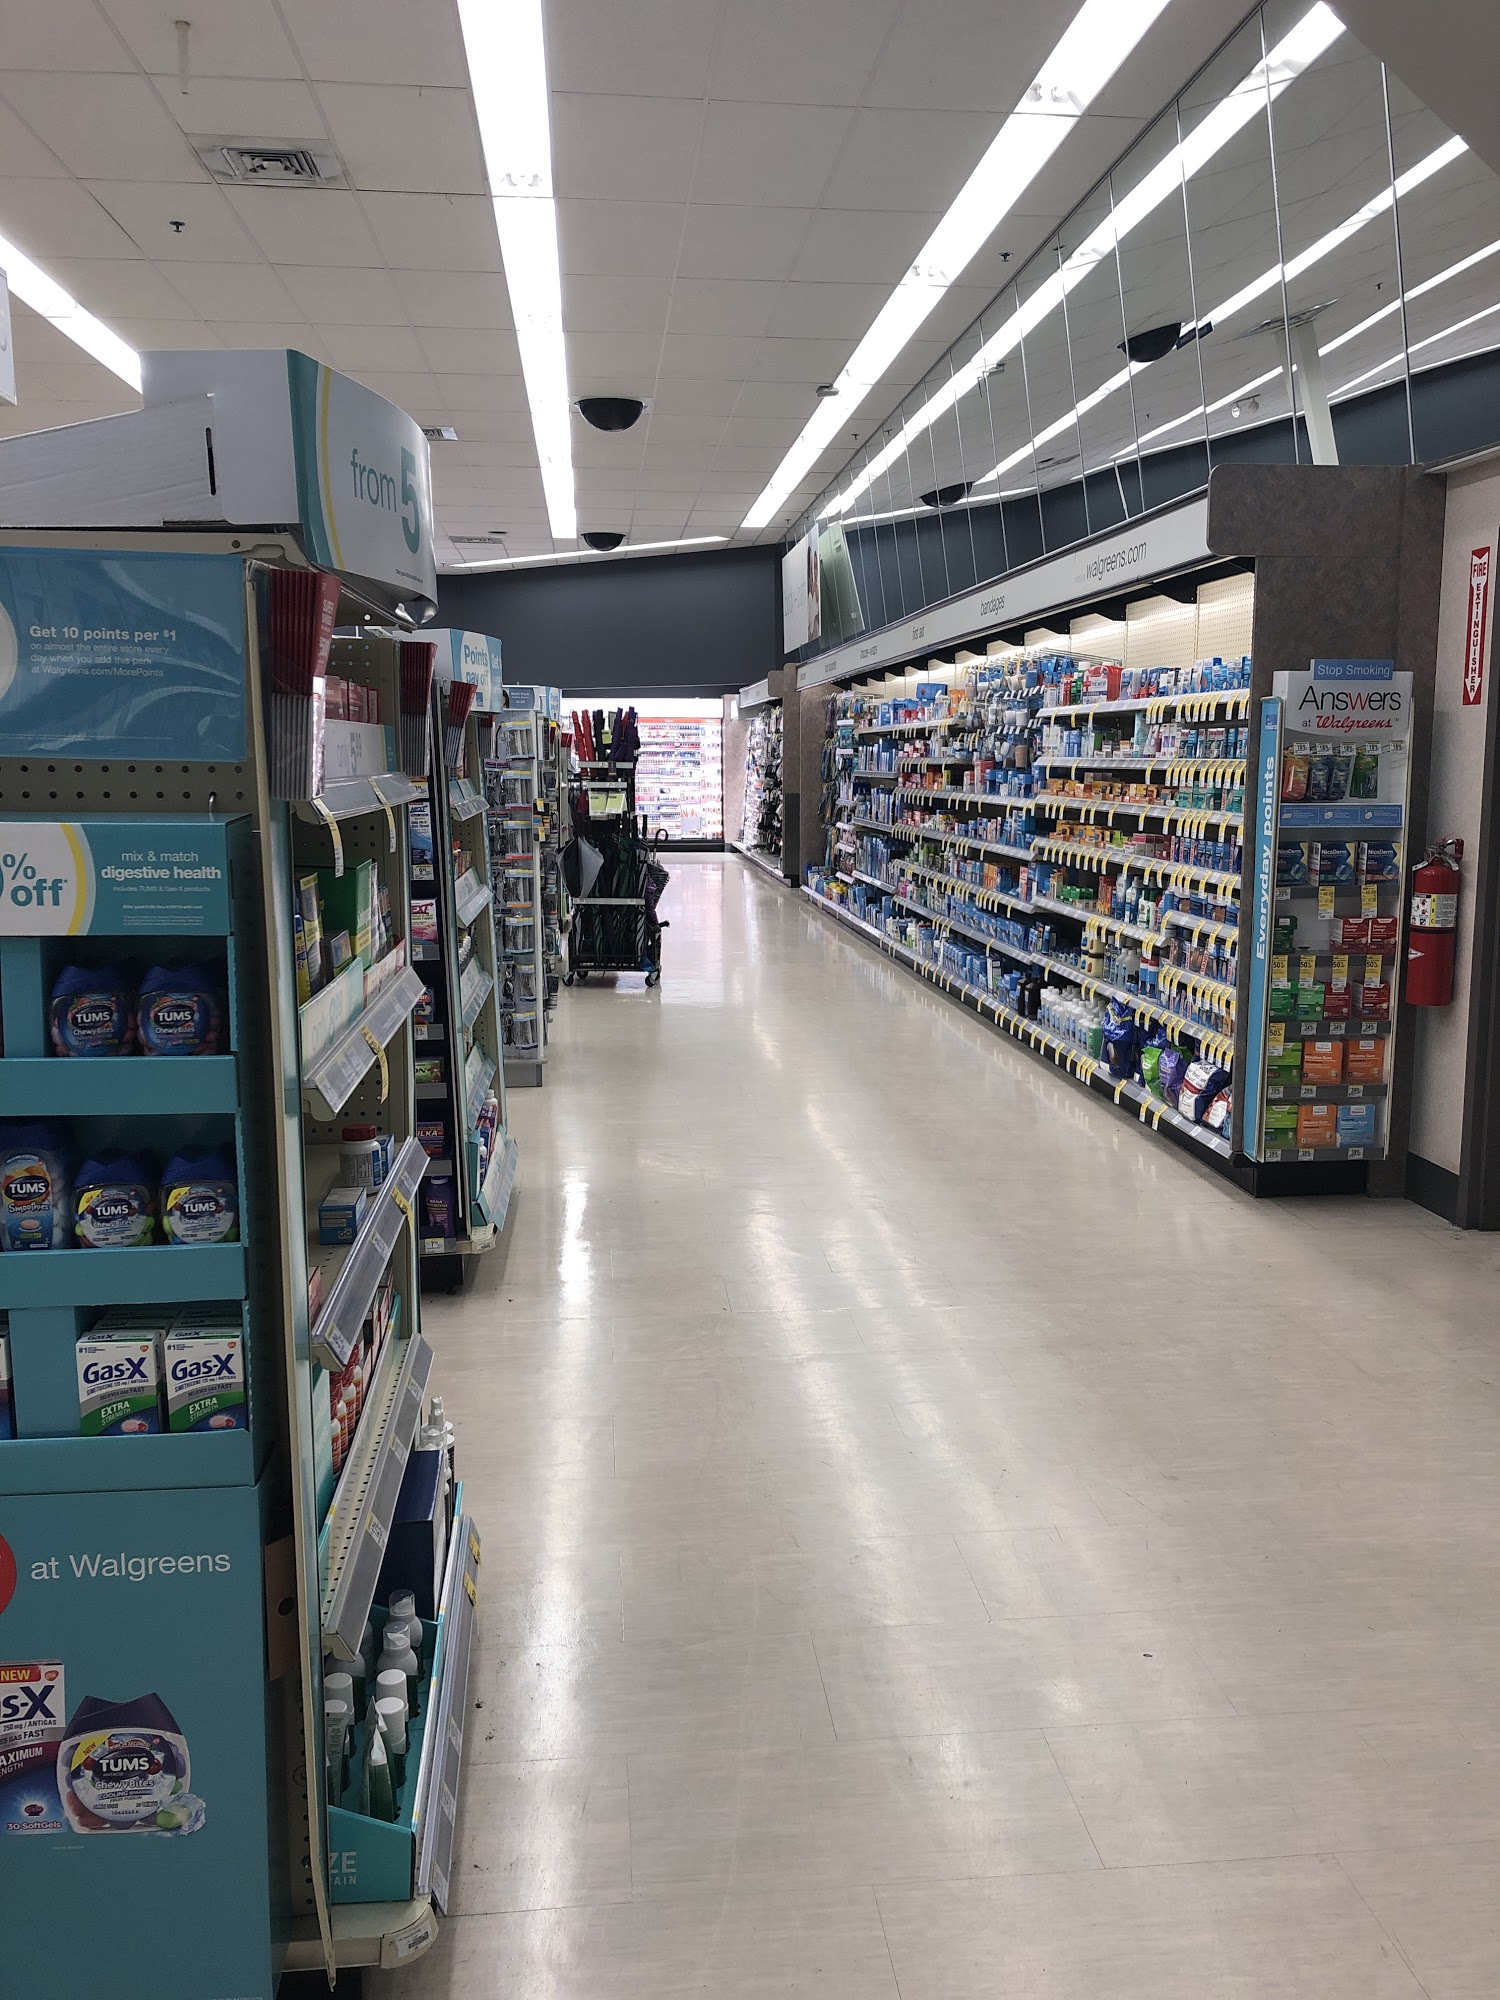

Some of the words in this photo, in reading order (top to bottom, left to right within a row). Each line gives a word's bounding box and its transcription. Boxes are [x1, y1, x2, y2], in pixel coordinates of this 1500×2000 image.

[351, 448, 397, 513] from
[401, 446, 420, 554] 5
[1086, 541, 1147, 580] walgreens.com
[1473, 562, 1486, 578] FIRE
[981, 595, 1005, 616] bandages
[29, 625, 56, 638] Get
[62, 627, 79, 639] 10
[83, 628, 130, 641] points
[134, 631, 159, 642] per
[163, 629, 176, 642] $1
[1469, 583, 1481, 693] EXTINGUISHER
[44, 642, 75, 651] almost
[76, 643, 91, 651] the
[93, 644, 118, 652] entire
[119, 645, 142, 653] store
[144, 646, 169, 655] every
[30, 654, 47, 664] day
[50, 655, 74, 663] when
[76, 657, 92, 665] you
[95, 656, 112, 664] add
[114, 656, 129, 664] this
[132, 657, 152, 666] perk
[464, 645, 488, 668] Points
[42, 666, 164, 677] Walgreens.com/MorePoints
[1317, 665, 1343, 677] Stop
[1346, 665, 1390, 677] Smoking
[1298, 685, 1401, 711] Answers
[1301, 719, 1311, 728] at
[1263, 756, 1275, 836] points
[121, 851, 144, 862] mix
[147, 850, 157, 862] &
[160, 850, 199, 862] match
[100, 866, 170, 881] digestive
[173, 866, 222, 880] health
[1256, 845, 1272, 960] Everyday
[76, 1011, 110, 1023] TUMS
[157, 1011, 192, 1022] TUMS
[73, 1027, 96, 1035] Chewy
[97, 1026, 114, 1034] Bites
[155, 1026, 177, 1035] Chewy
[8, 1182, 46, 1194] TUMS
[8, 1202, 50, 1213] Smoothies
[95, 1204, 129, 1216] TUMS
[183, 1202, 217, 1213] TUMS
[93, 1220, 115, 1229] Chewy
[115, 1219, 133, 1227] Bites
[181, 1217, 202, 1227] Chewy
[202, 1216, 221, 1225] Bites
[83, 1357, 147, 1384] Gas-X
[172, 1354, 235, 1381] Gas-X
[129, 1386, 145, 1394] FAST
[217, 1383, 232, 1391] FAST
[101, 1401, 130, 1418] EXTRA
[189, 1397, 218, 1414] EXTRA
[101, 1407, 131, 1426] STRENGTH
[190, 1403, 219, 1422] STRENGTH
[31, 1557, 60, 1580] at
[69, 1552, 231, 1582] Walgreens
[0, 1670, 30, 1681] NEW
[0, 1685, 56, 1719] s-X
[3, 1724, 14, 1732] 250
[28, 1719, 57, 1728] ANTIGAS
[9, 1735, 22, 1743] GAS
[24, 1729, 46, 1739] FAST
[83, 1741, 97, 1756] NEW
[0, 1747, 43, 1767] AXIMUM
[99, 1758, 150, 1772] TUMS
[95, 1780, 128, 1790] Chewy
[129, 1777, 154, 1788] Bites
[98, 1791, 128, 1800] COOLING
[22, 1821, 62, 1831] SoftGels
[333, 1876, 356, 1886] AIN
